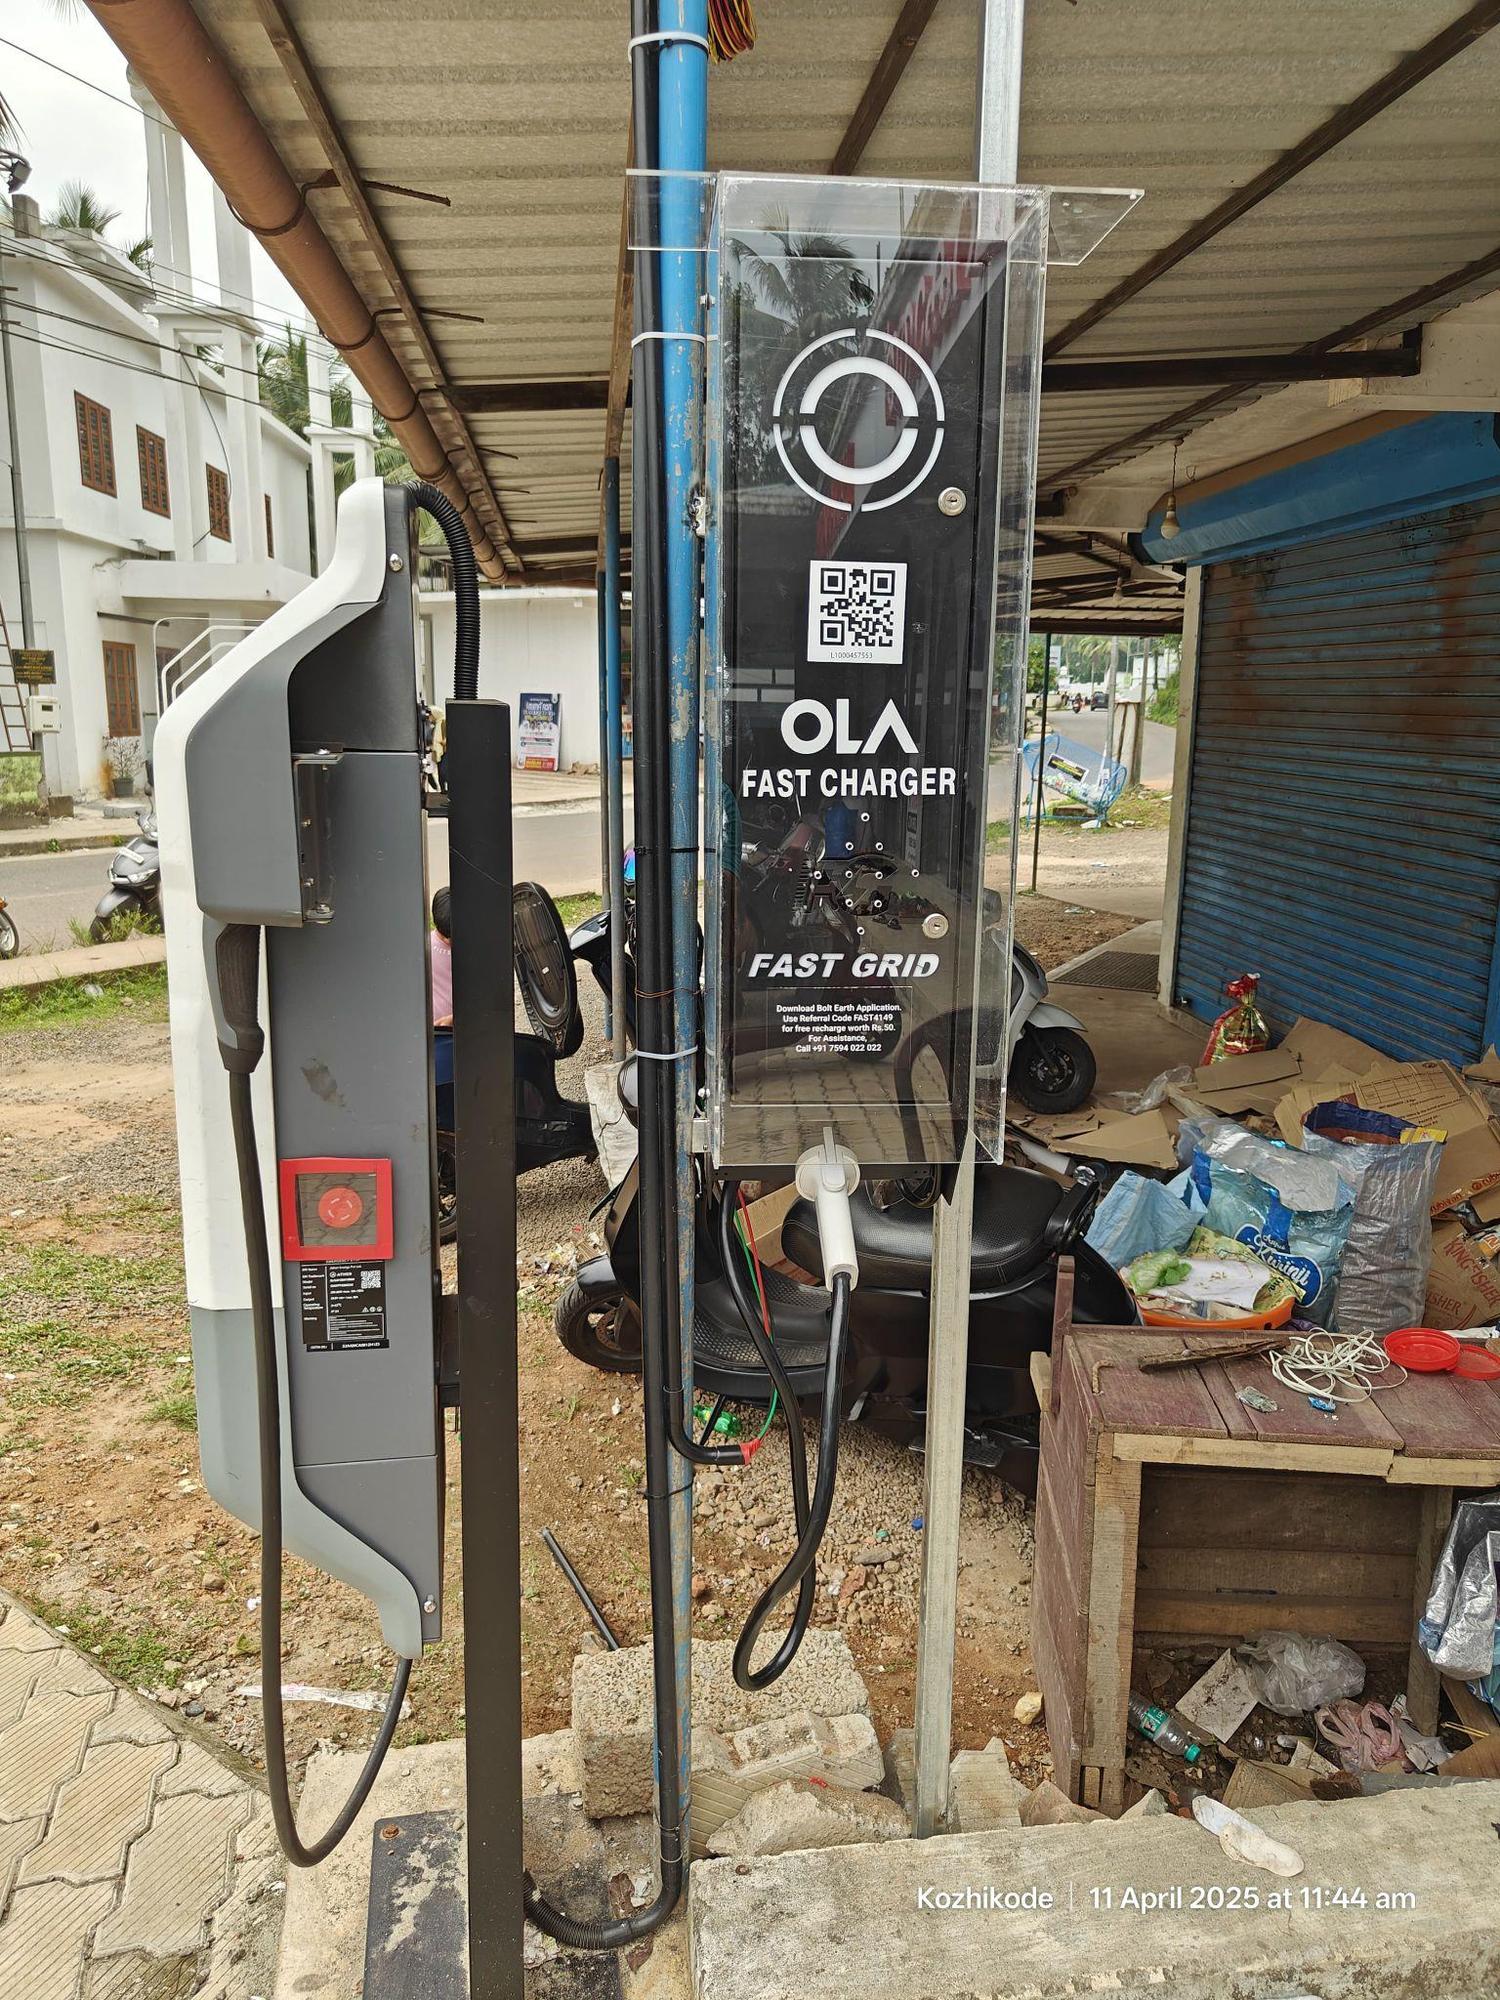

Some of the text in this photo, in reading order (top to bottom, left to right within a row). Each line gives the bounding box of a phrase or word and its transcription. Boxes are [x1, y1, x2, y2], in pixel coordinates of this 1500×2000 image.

[780, 698, 919, 755] OLA
[742, 767, 956, 799] FAST CHARGER
[748, 952, 940, 978] FAST GRID
[776, 1003, 902, 1013] Download Bolt Earth Application.
[782, 1013, 894, 1023] Use Referral Code FAST4149
[781, 1023, 896, 1034] for free recharge worth Rs.50.
[808, 1034, 868, 1043] For Assistance,
[795, 1043, 882, 1052] Call +91 7594 022 022
